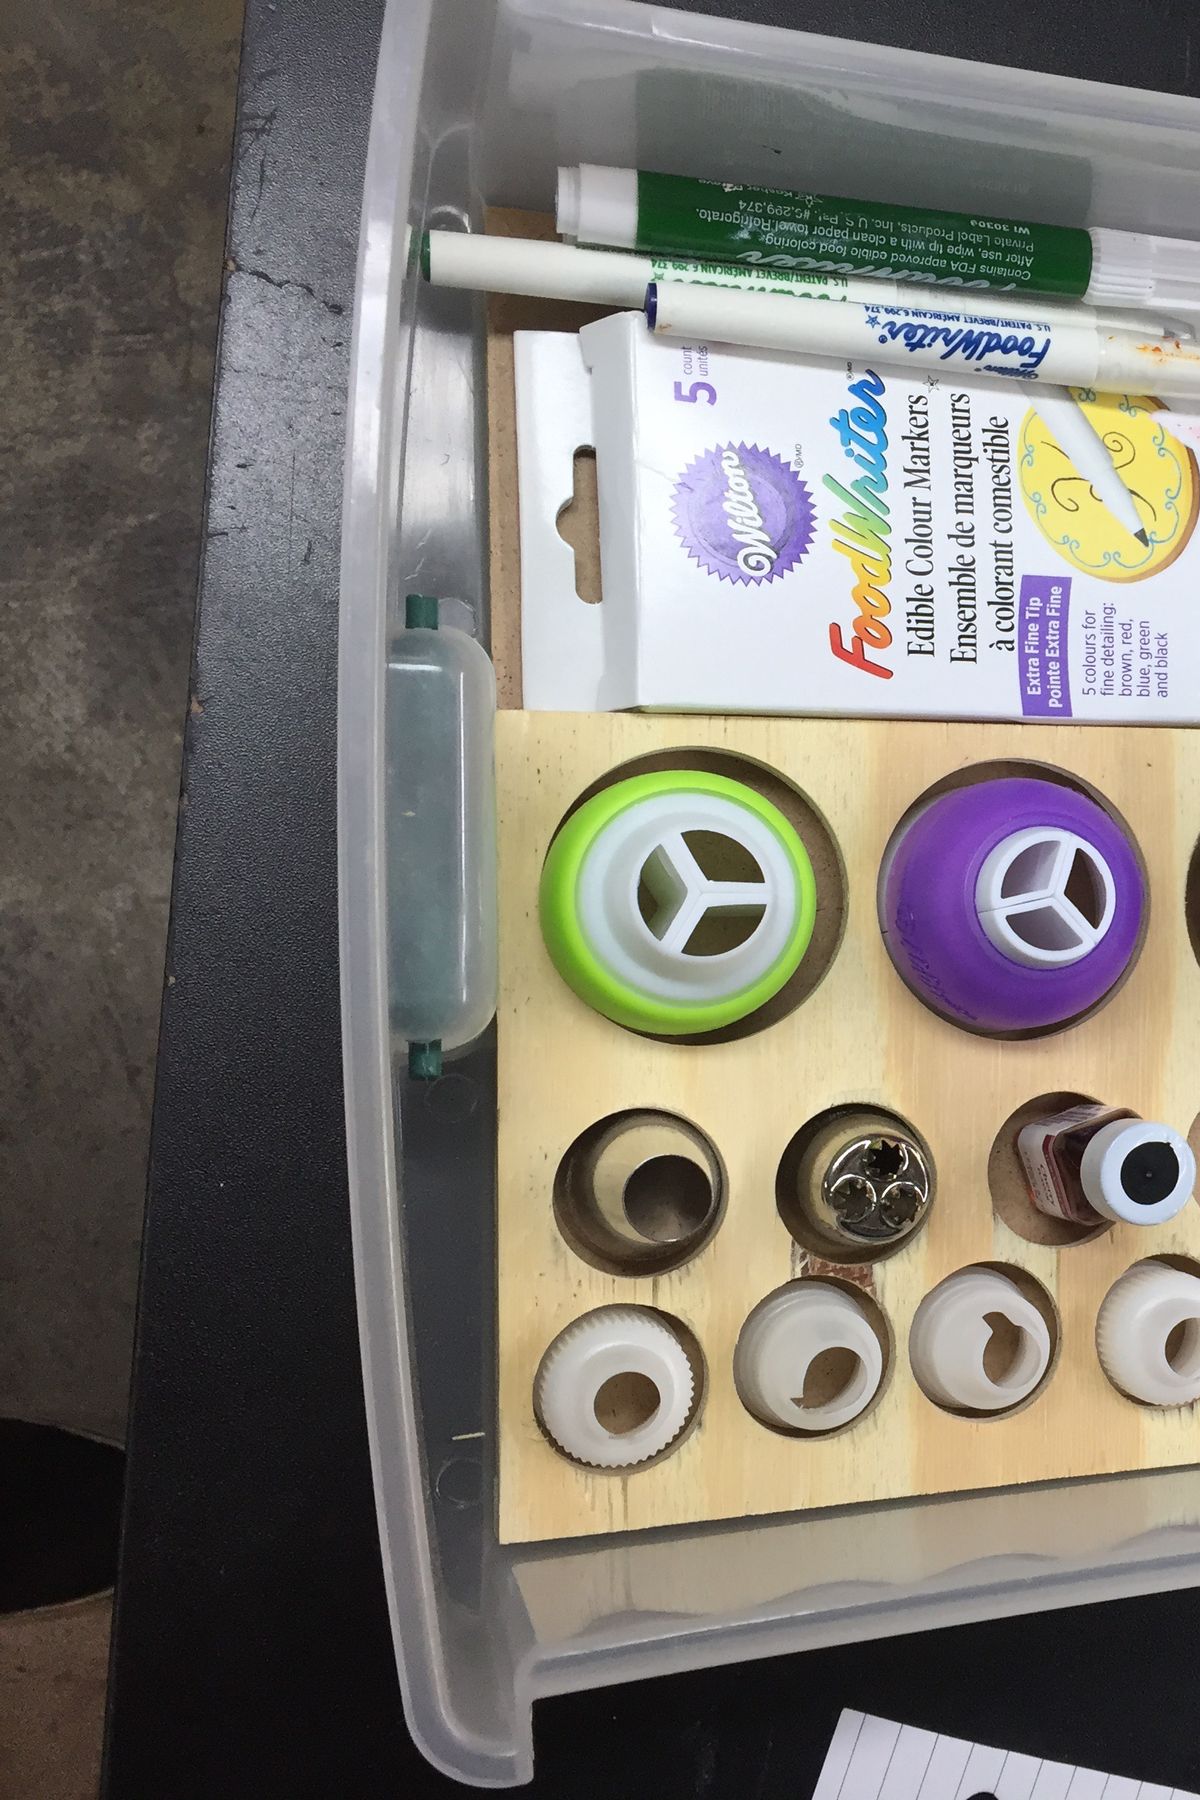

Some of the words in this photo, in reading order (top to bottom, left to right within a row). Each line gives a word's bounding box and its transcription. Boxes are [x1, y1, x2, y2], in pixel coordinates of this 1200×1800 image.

[812, 225, 849, 239] paper
[871, 218, 894, 232] Inc.
[897, 222, 954, 241] Products,
[957, 231, 990, 246] Label
[819, 243, 847, 257] food
[852, 232, 886, 247] clean
[889, 236, 898, 245] a
[901, 239, 925, 252] with
[928, 240, 943, 254] tip
[946, 244, 975, 258] wipe
[994, 236, 1034, 252] Private
[851, 247, 887, 261] edible
[889, 252, 947, 268] approved
[950, 260, 977, 274] FDA
[978, 248, 1003, 260] use,
[1005, 252, 1034, 267] After
[979, 265, 1032, 281] Contains
[881, 321, 1052, 368] FoodWriter
[681, 346, 693, 375] count
[698, 345, 709, 377] unités
[673, 380, 718, 406] 5
[902, 394, 931, 491] Markers
[950, 392, 979, 516] marqueurs
[982, 415, 1013, 534] comestible
[722, 450, 778, 577] Wilton
[822, 368, 894, 680] FoodWriter
[905, 496, 934, 577] Colour
[947, 520, 975, 549] de
[987, 540, 1015, 632] colorant
[948, 553, 978, 665] Ensemble
[1025, 596, 1043, 619] Tip
[1046, 585, 1063, 617] Fine
[907, 583, 935, 657] Edible
[1082, 610, 1096, 630] for
[1118, 618, 1134, 645] red,
[988, 638, 1015, 652] à
[1024, 622, 1040, 654] Fine
[1045, 620, 1060, 658] Extra
[1100, 602, 1116, 667] detailing:
[1138, 620, 1153, 661] green
[1082, 633, 1096, 684] colours
[1154, 632, 1168, 668] black
[1026, 657, 1042, 696] Extra
[1046, 661, 1063, 708] Pointe
[1100, 670, 1115, 696] fine
[1119, 649, 1134, 697] brown,
[1136, 664, 1152, 697] blue,
[1154, 672, 1168, 698] and
[1082, 687, 1096, 696] 5
